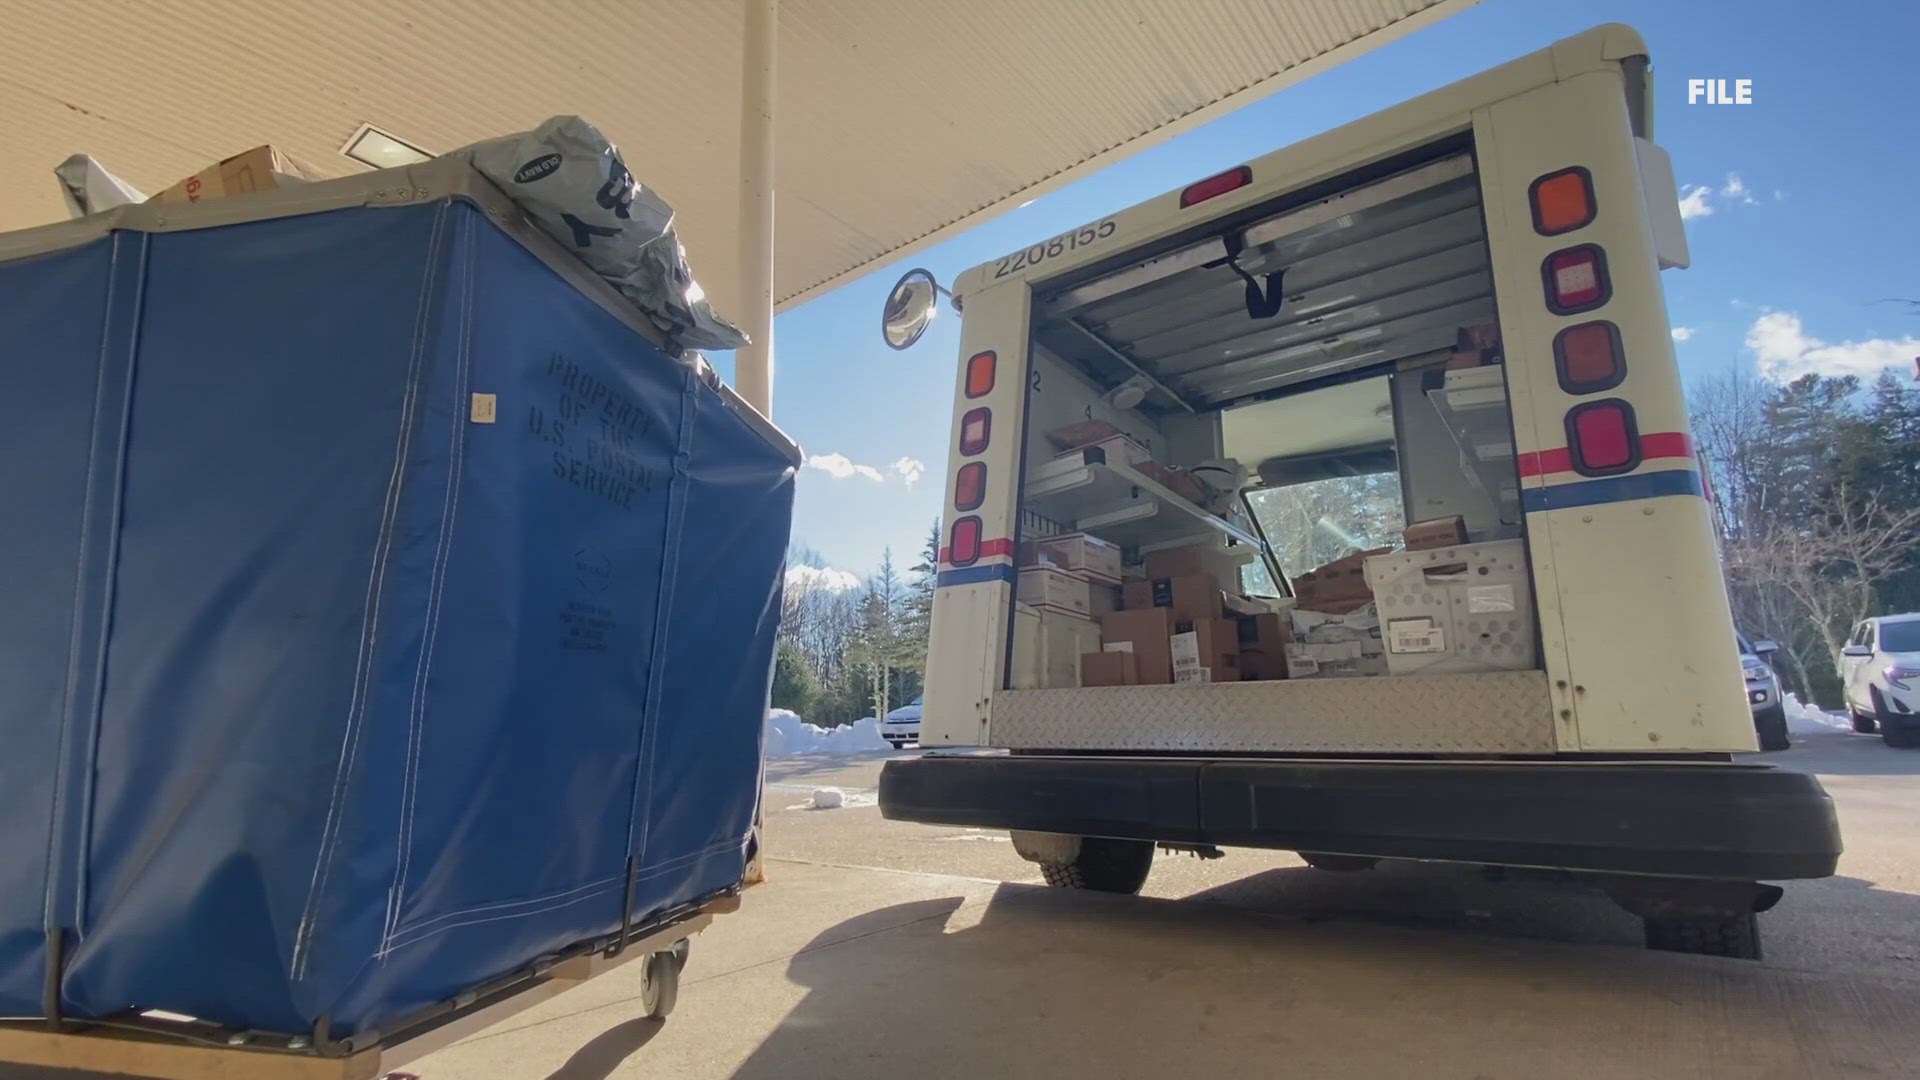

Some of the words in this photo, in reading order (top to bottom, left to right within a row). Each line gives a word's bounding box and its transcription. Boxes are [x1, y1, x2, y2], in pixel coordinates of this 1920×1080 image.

[518, 163, 543, 181] NAVY
[541, 157, 560, 171] OLD
[994, 220, 1117, 279] 2208155
[547, 352, 651, 438] PROPERTY
[560, 393, 586, 425] OF
[599, 416, 633, 447] THE
[529, 405, 573, 453] U.S.
[587, 437, 652, 493] POSTAL
[553, 451, 636, 511] SERVICE
